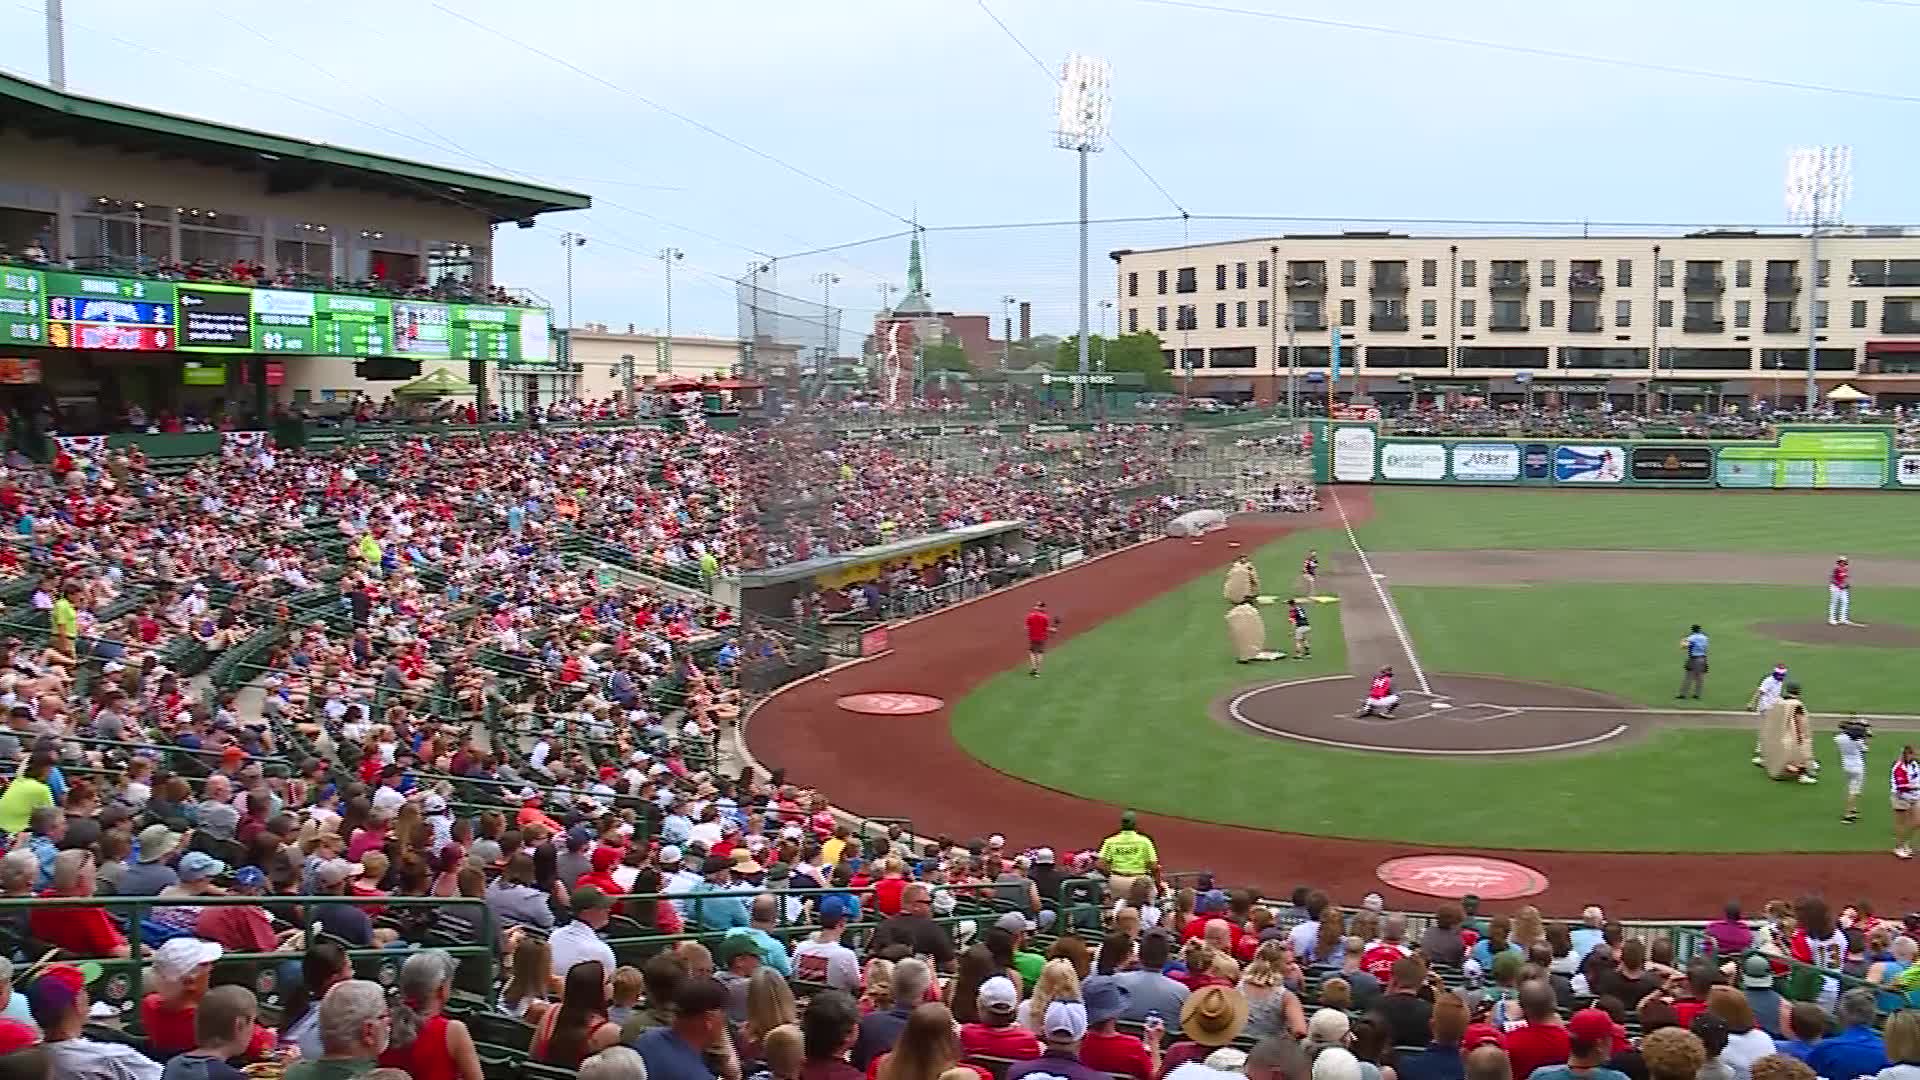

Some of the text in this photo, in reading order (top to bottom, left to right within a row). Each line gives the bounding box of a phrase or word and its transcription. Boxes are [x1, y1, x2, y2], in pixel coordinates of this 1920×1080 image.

[154, 305, 167, 324] 2
[155, 330, 168, 349] 0
[264, 332, 284, 350] 93
